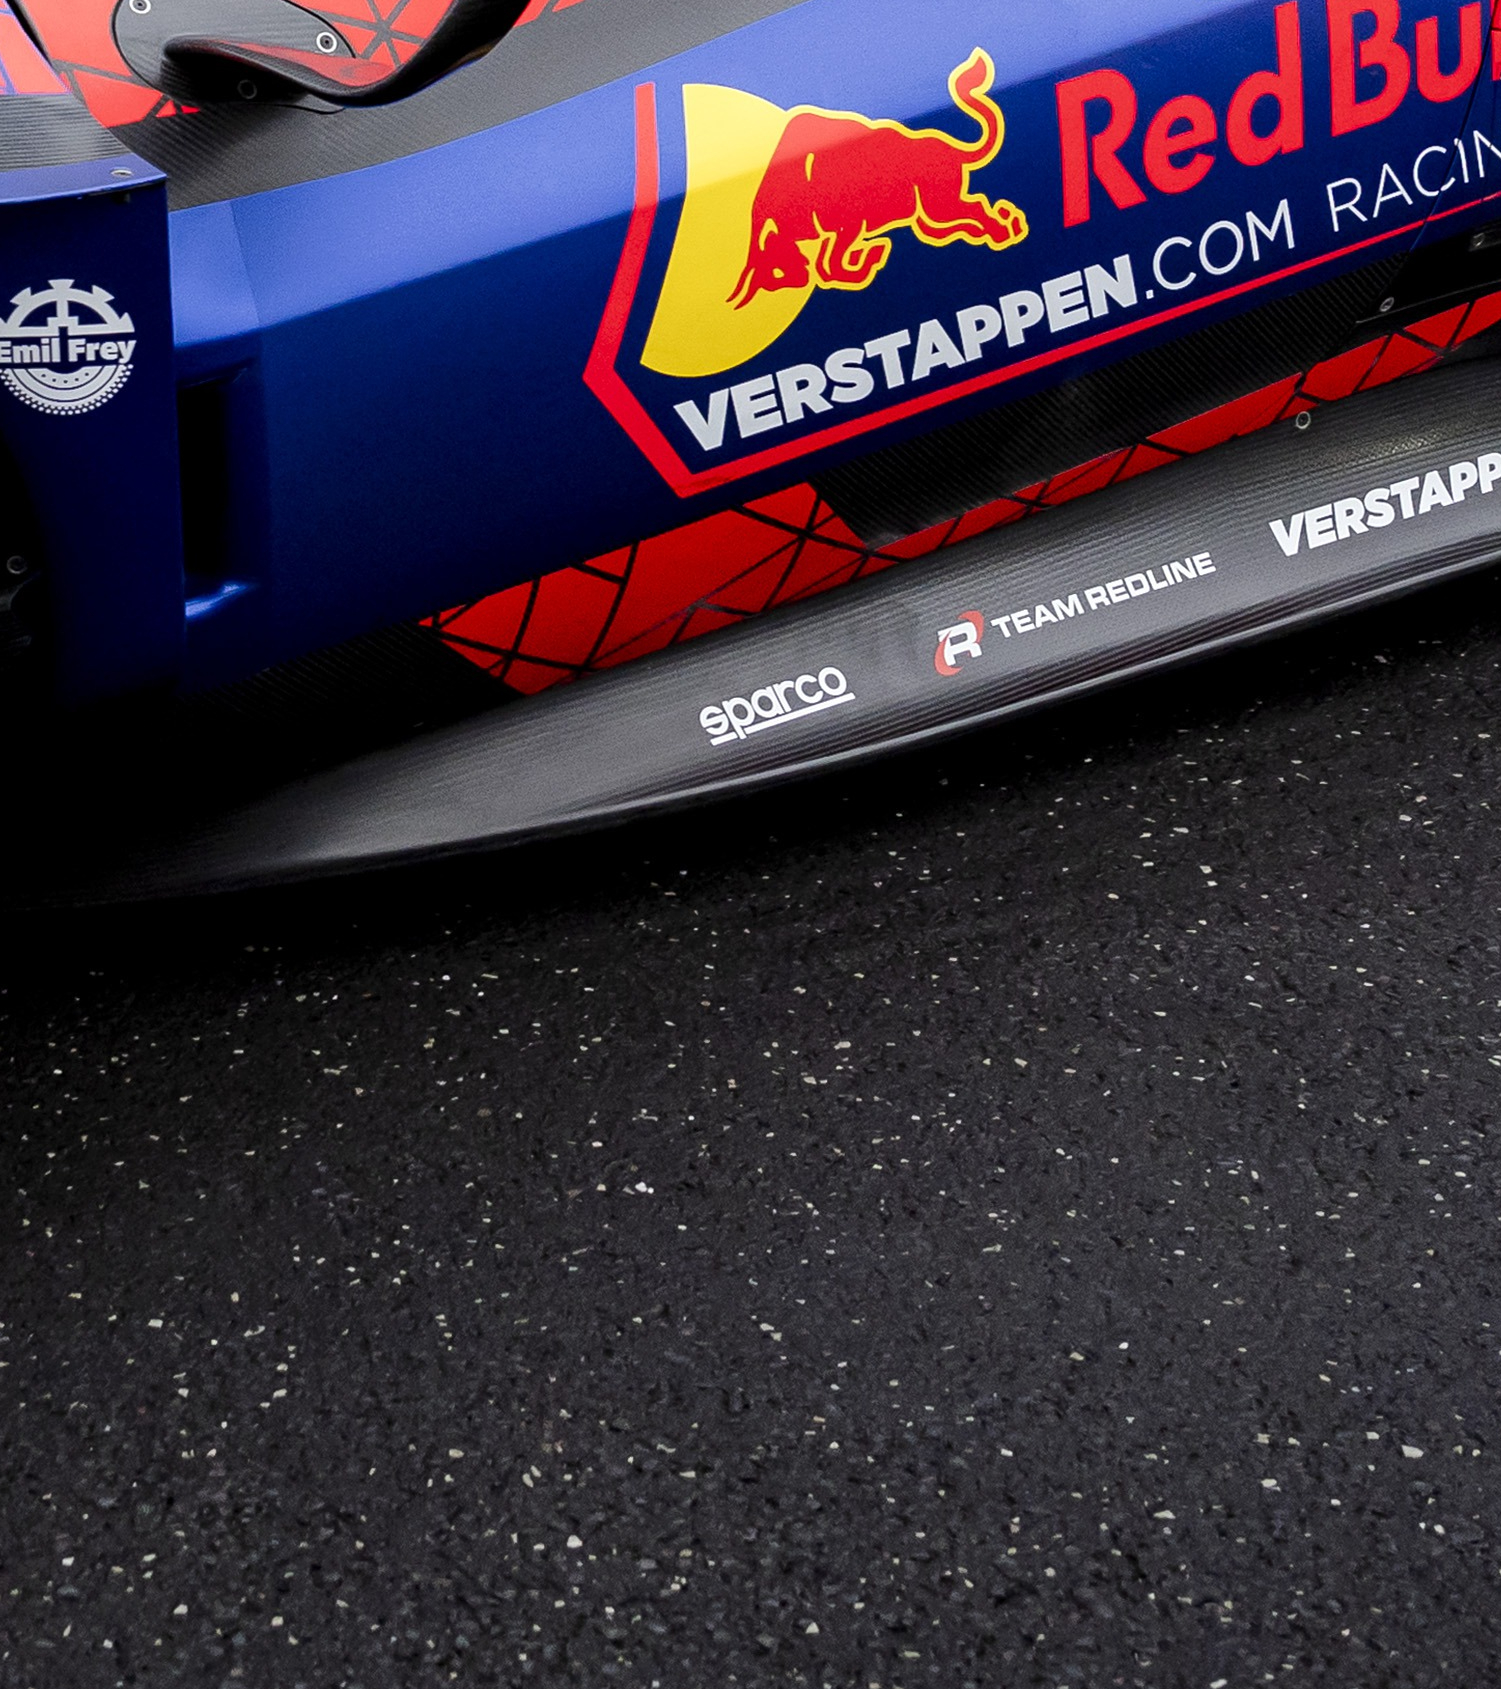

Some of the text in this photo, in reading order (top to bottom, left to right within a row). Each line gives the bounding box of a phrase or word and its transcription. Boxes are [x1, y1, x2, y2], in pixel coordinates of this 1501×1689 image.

[1053, 0, 1305, 229] Red
[67, 339, 137, 365] Frey
[671, 196, 1297, 454] VERSTAPPEN.COM
[990, 591, 1087, 640] TEAM
[1086, 551, 1218, 611] REDLINE
[698, 665, 856, 747] sparco
